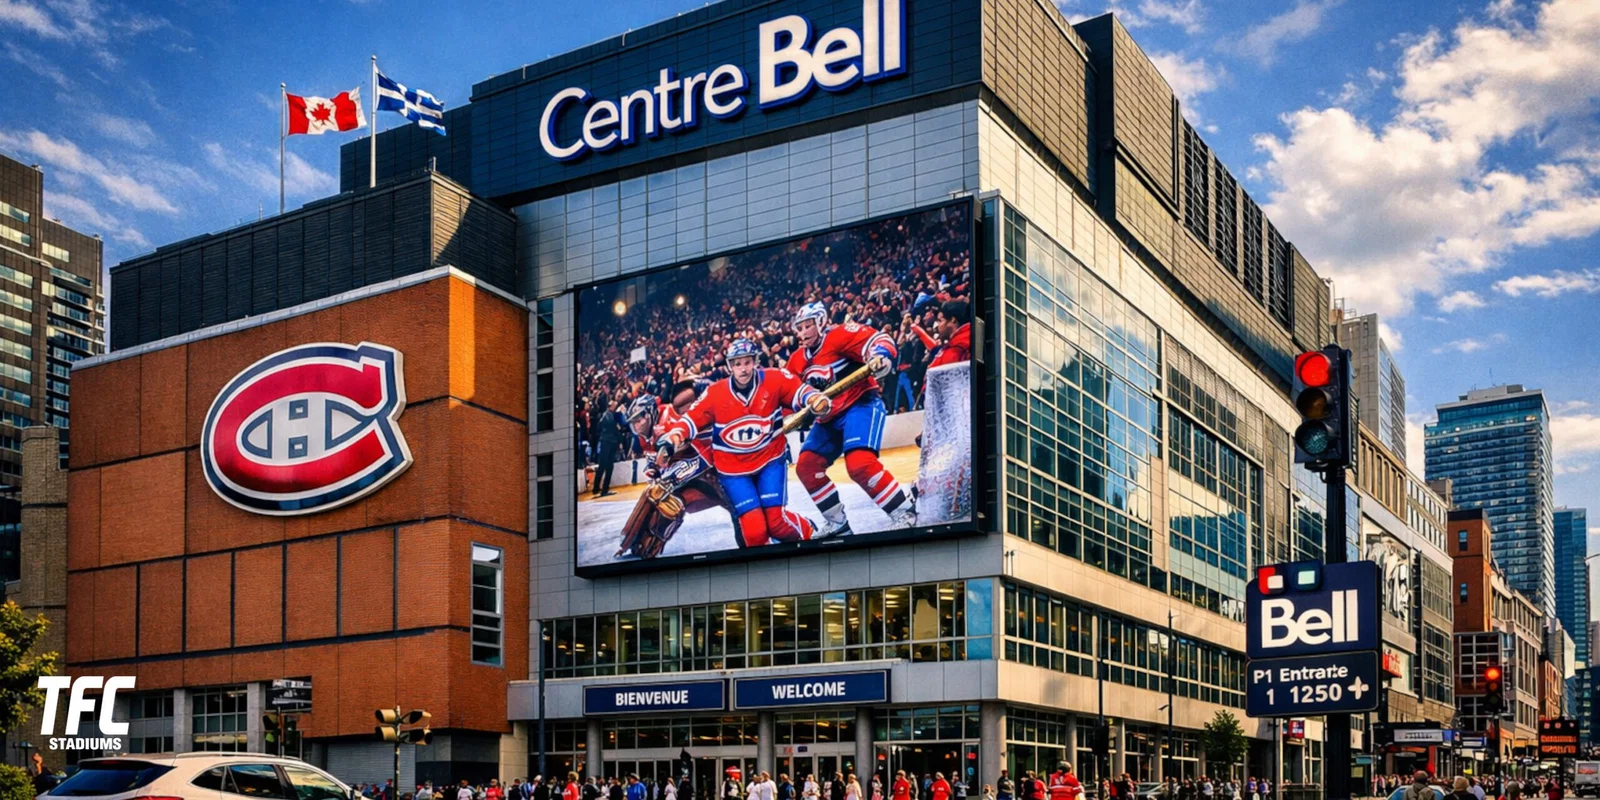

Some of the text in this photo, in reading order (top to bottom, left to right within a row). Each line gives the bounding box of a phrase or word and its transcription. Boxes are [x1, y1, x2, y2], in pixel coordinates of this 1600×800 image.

[539, 0, 905, 160] Centre Bell
[1260, 589, 1359, 649] Bell
[1253, 669, 1272, 684] P1
[615, 690, 689, 706] BIENVENUE
[771, 681, 846, 699] WELCOME
[1266, 683, 1342, 705] 1 1250
